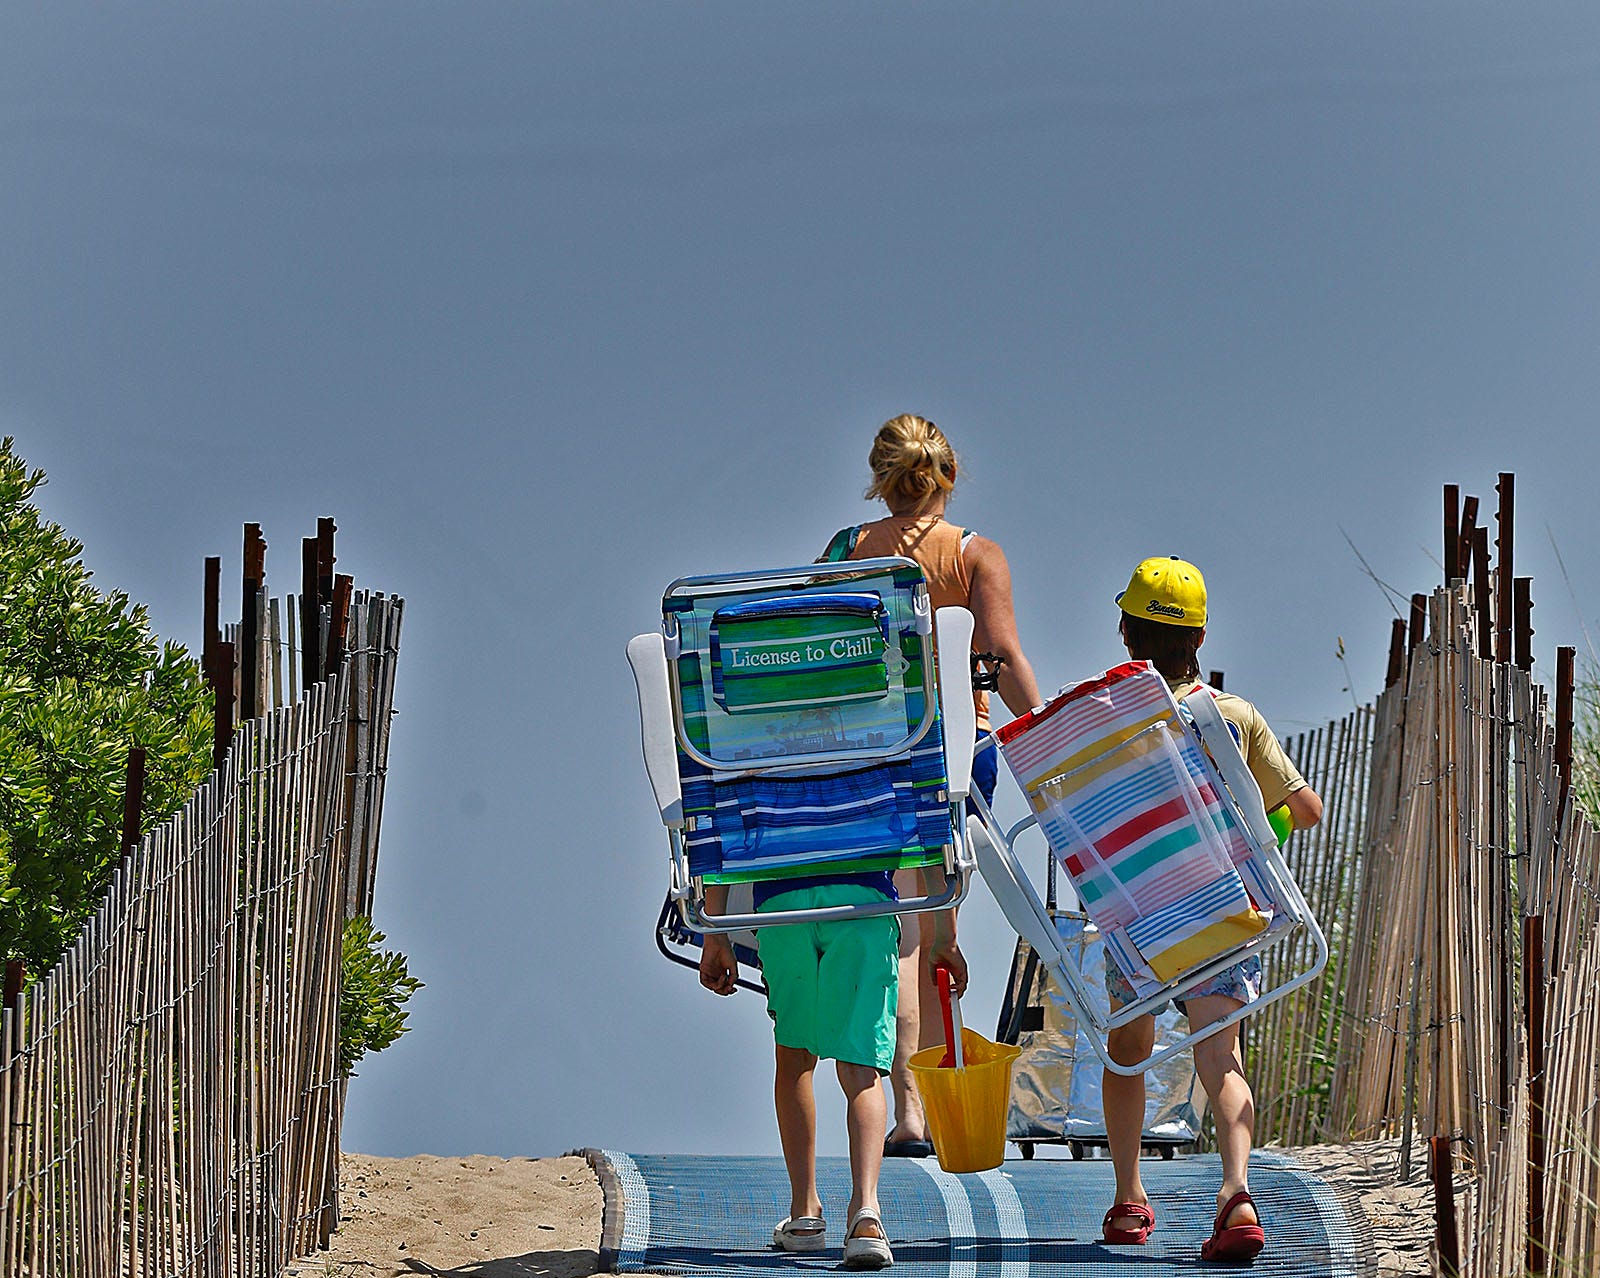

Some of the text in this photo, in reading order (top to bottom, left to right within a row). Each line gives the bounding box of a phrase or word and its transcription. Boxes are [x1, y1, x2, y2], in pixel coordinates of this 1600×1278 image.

[731, 637, 873, 667] License to Chill
